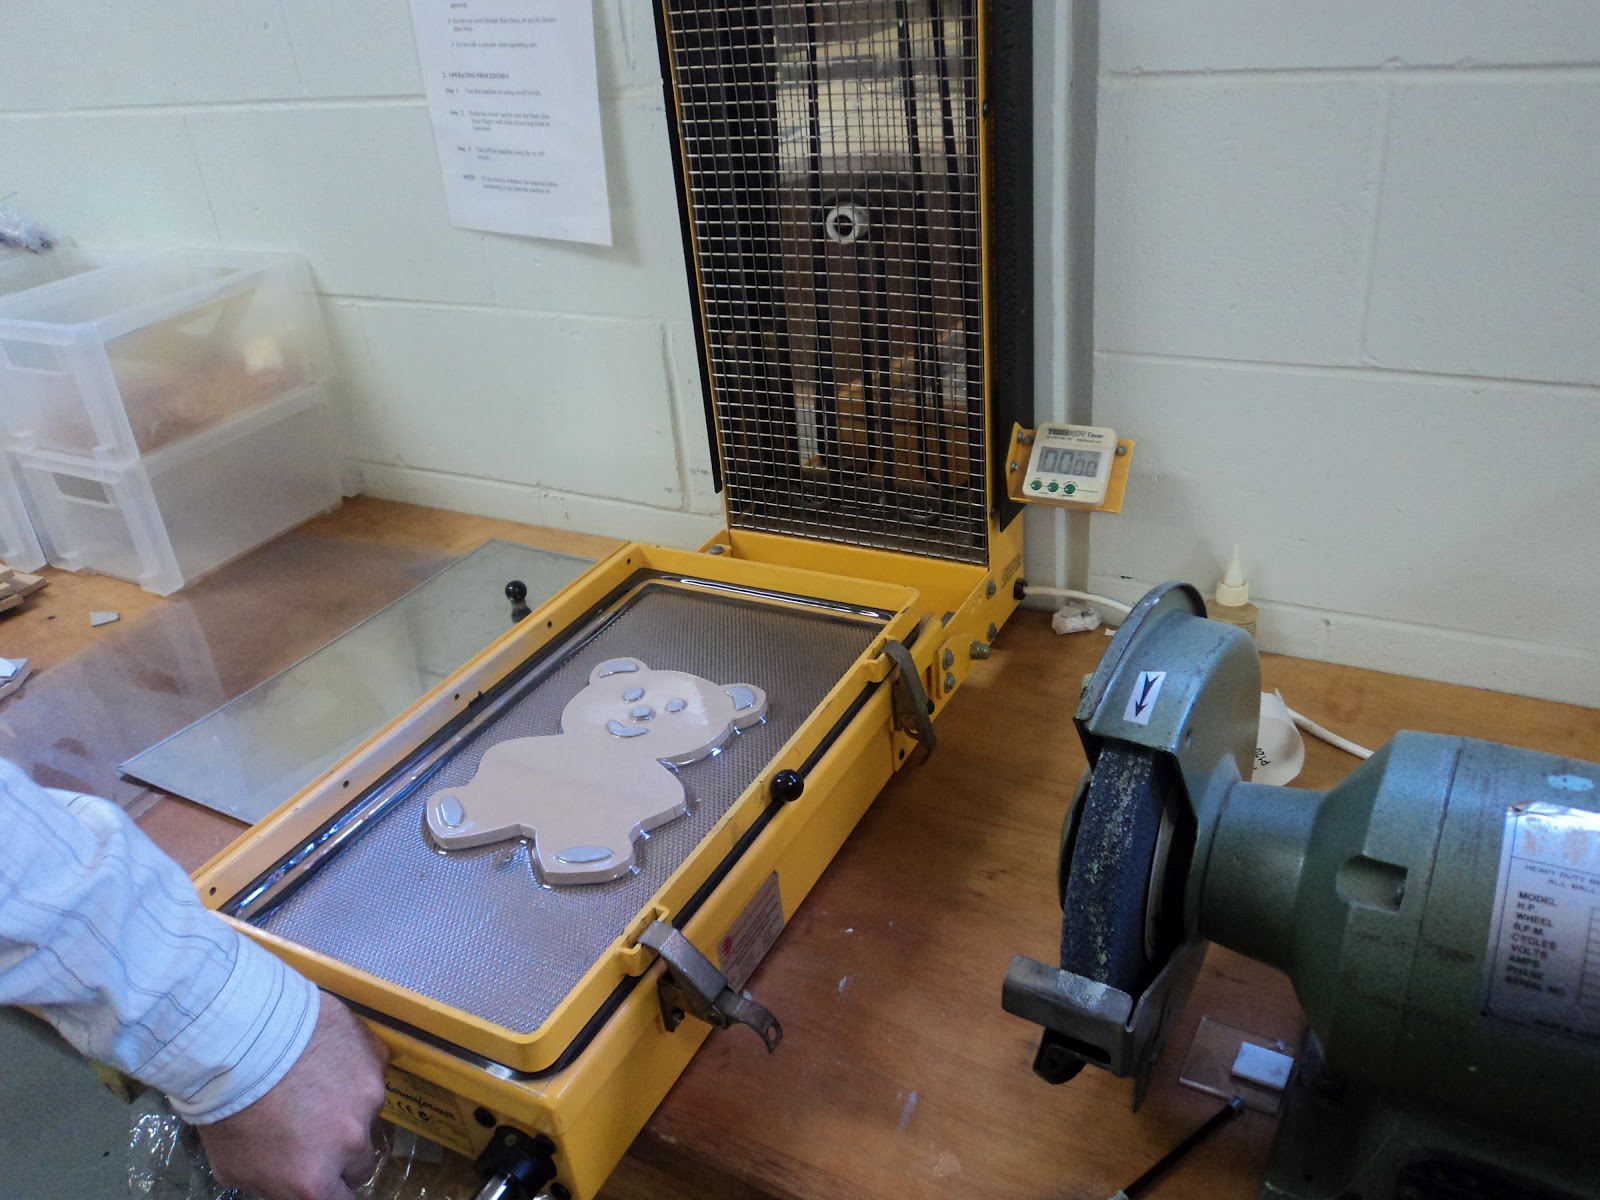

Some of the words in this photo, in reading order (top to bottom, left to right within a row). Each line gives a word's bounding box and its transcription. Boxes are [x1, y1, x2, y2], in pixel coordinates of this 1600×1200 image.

[1518, 891, 1558, 907] MODEL
[1516, 911, 1554, 928] WHEEL
[1511, 933, 1558, 950] CYCLES
[1510, 943, 1548, 960] VOLTS
[385, 1082, 456, 1121] hermoformer
